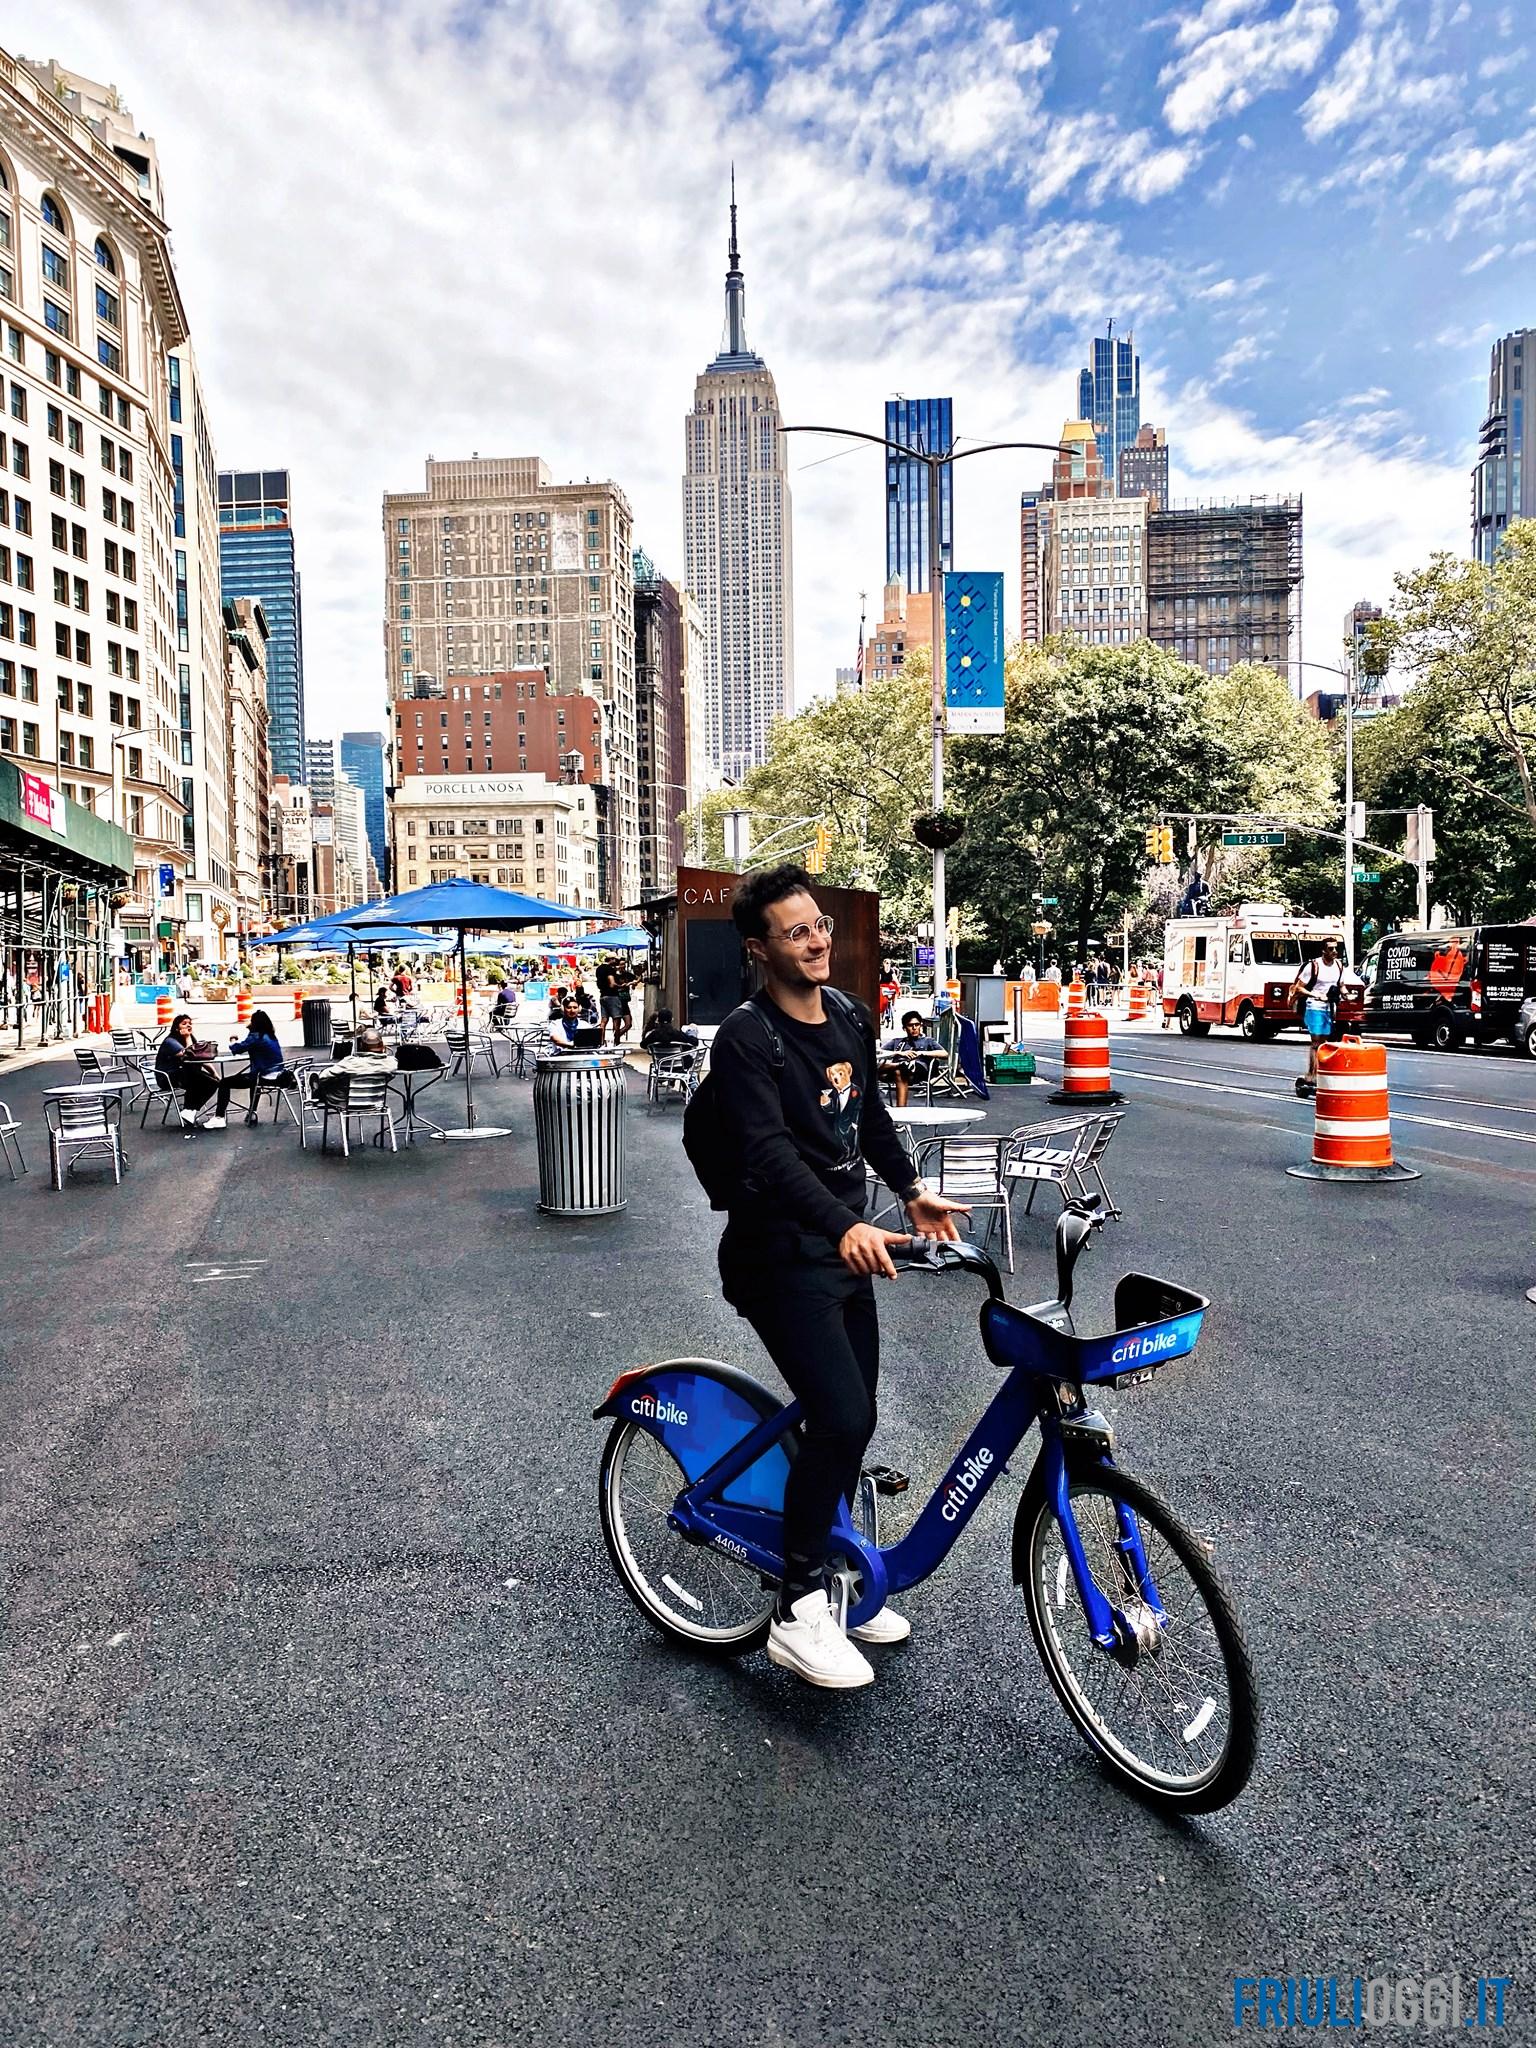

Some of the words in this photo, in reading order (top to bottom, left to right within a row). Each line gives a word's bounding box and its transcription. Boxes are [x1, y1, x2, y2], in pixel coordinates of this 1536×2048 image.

[426, 782, 524, 794] PORCELANOSA
[1238, 835, 1244, 844] E
[1246, 835, 1257, 844] 23
[1260, 835, 1269, 844] St
[1356, 874, 1361, 882] E
[1362, 873, 1371, 882] 23
[684, 888, 730, 905] CAF
[1387, 946, 1411, 958] COVID
[1386, 957, 1417, 969] TESTING
[1385, 968, 1401, 980] SITE
[1112, 1341, 1140, 1363] citi
[1141, 1332, 1177, 1355] bike
[631, 1397, 655, 1418] citi
[656, 1399, 688, 1426] bike
[941, 1485, 969, 1521] citi
[955, 1447, 994, 1493] bike
[714, 1534, 748, 1558] 44045
